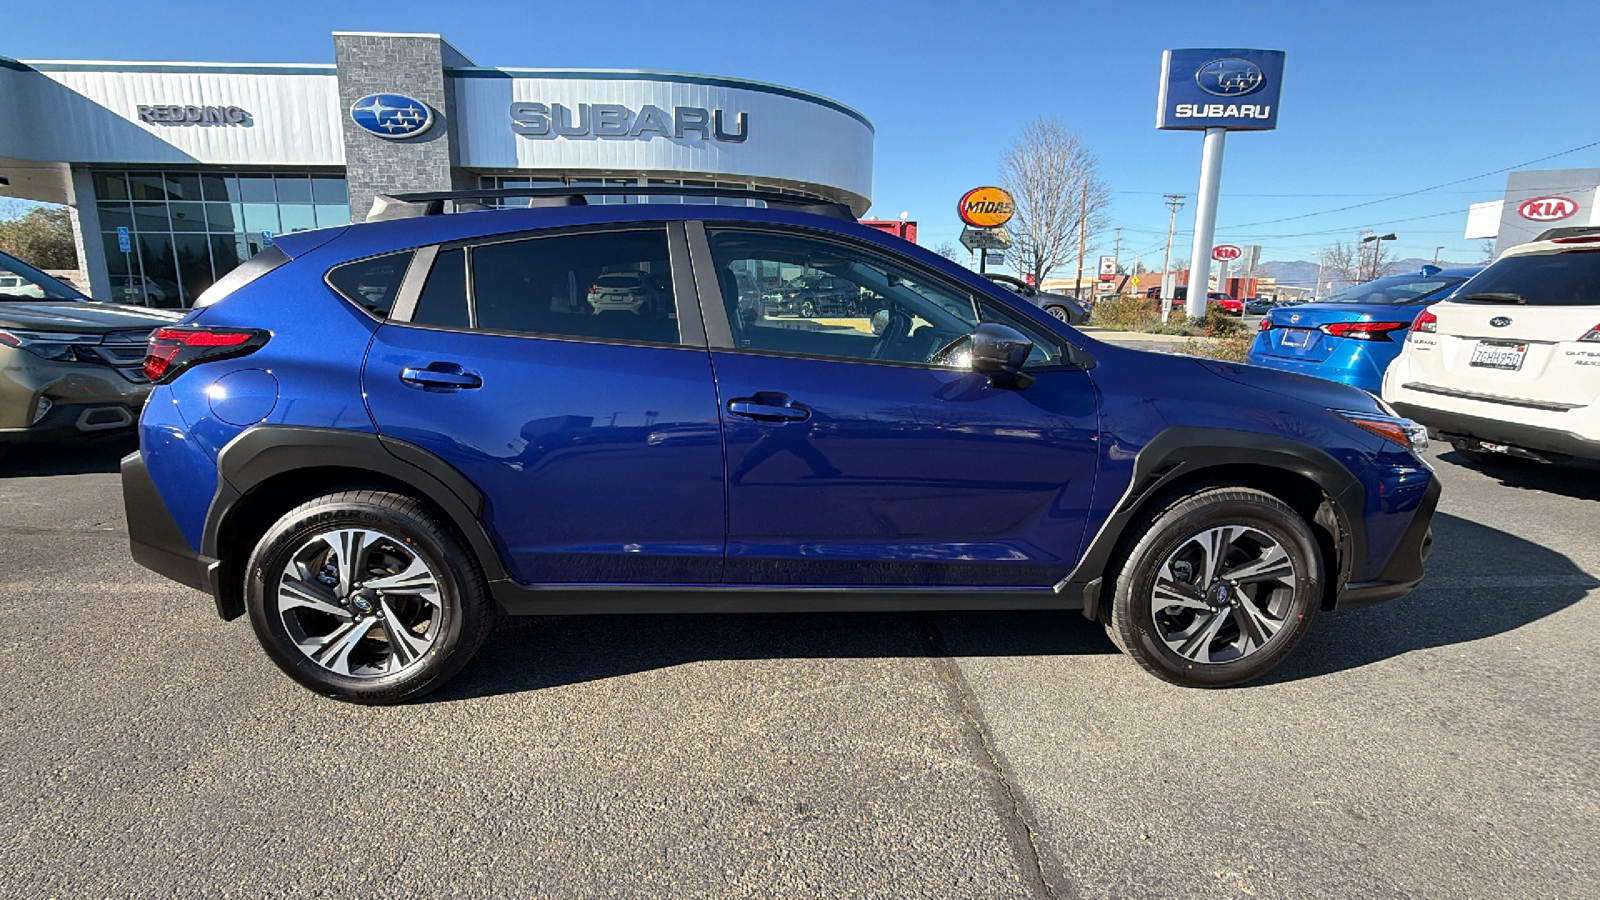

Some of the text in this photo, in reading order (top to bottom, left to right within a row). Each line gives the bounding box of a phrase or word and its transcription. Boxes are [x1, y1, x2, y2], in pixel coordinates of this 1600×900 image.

[136, 104, 244, 123] REDDING
[1175, 103, 1271, 119] SUBARU
[509, 101, 750, 144] SUBARU
[965, 200, 1012, 214] MIDAS
[1528, 201, 1567, 217] KIA
[1215, 248, 1238, 259] KIA
